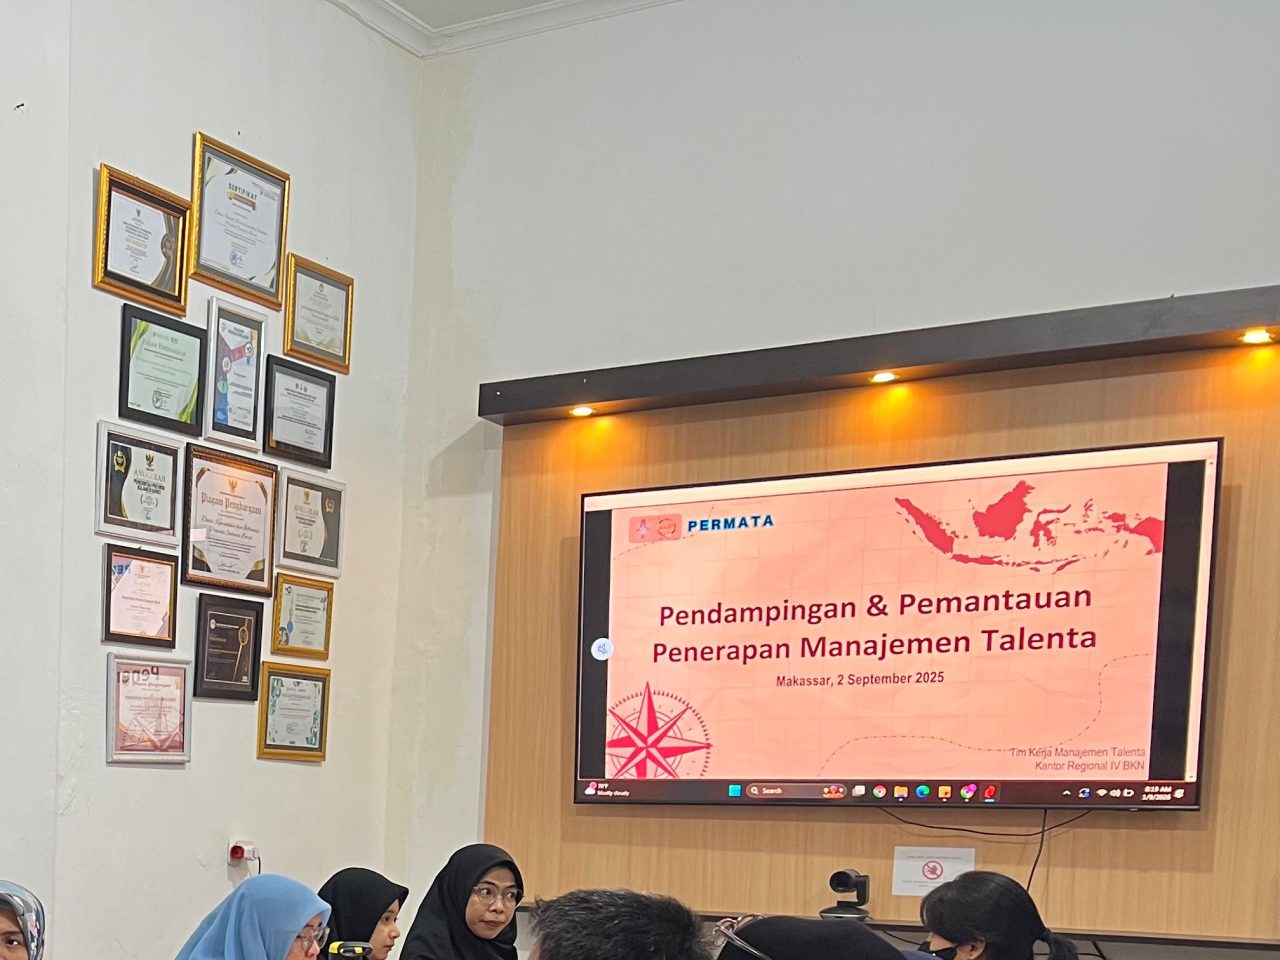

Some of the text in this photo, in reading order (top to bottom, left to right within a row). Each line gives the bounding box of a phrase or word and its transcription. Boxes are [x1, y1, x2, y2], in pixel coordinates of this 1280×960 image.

[687, 514, 774, 532] PERMATA
[660, 588, 1092, 626] Pendampingan & Pemantauan
[653, 626, 1097, 665] Penerapan Manajemen Talenta
[776, 671, 945, 688] Makassar, 2 September 2025
[1010, 746, 1146, 760] Tim Kerja Manajemen Talenta
[1035, 760, 1145, 773] Kantor Regional IV BKN
[762, 787, 783, 795] Search
